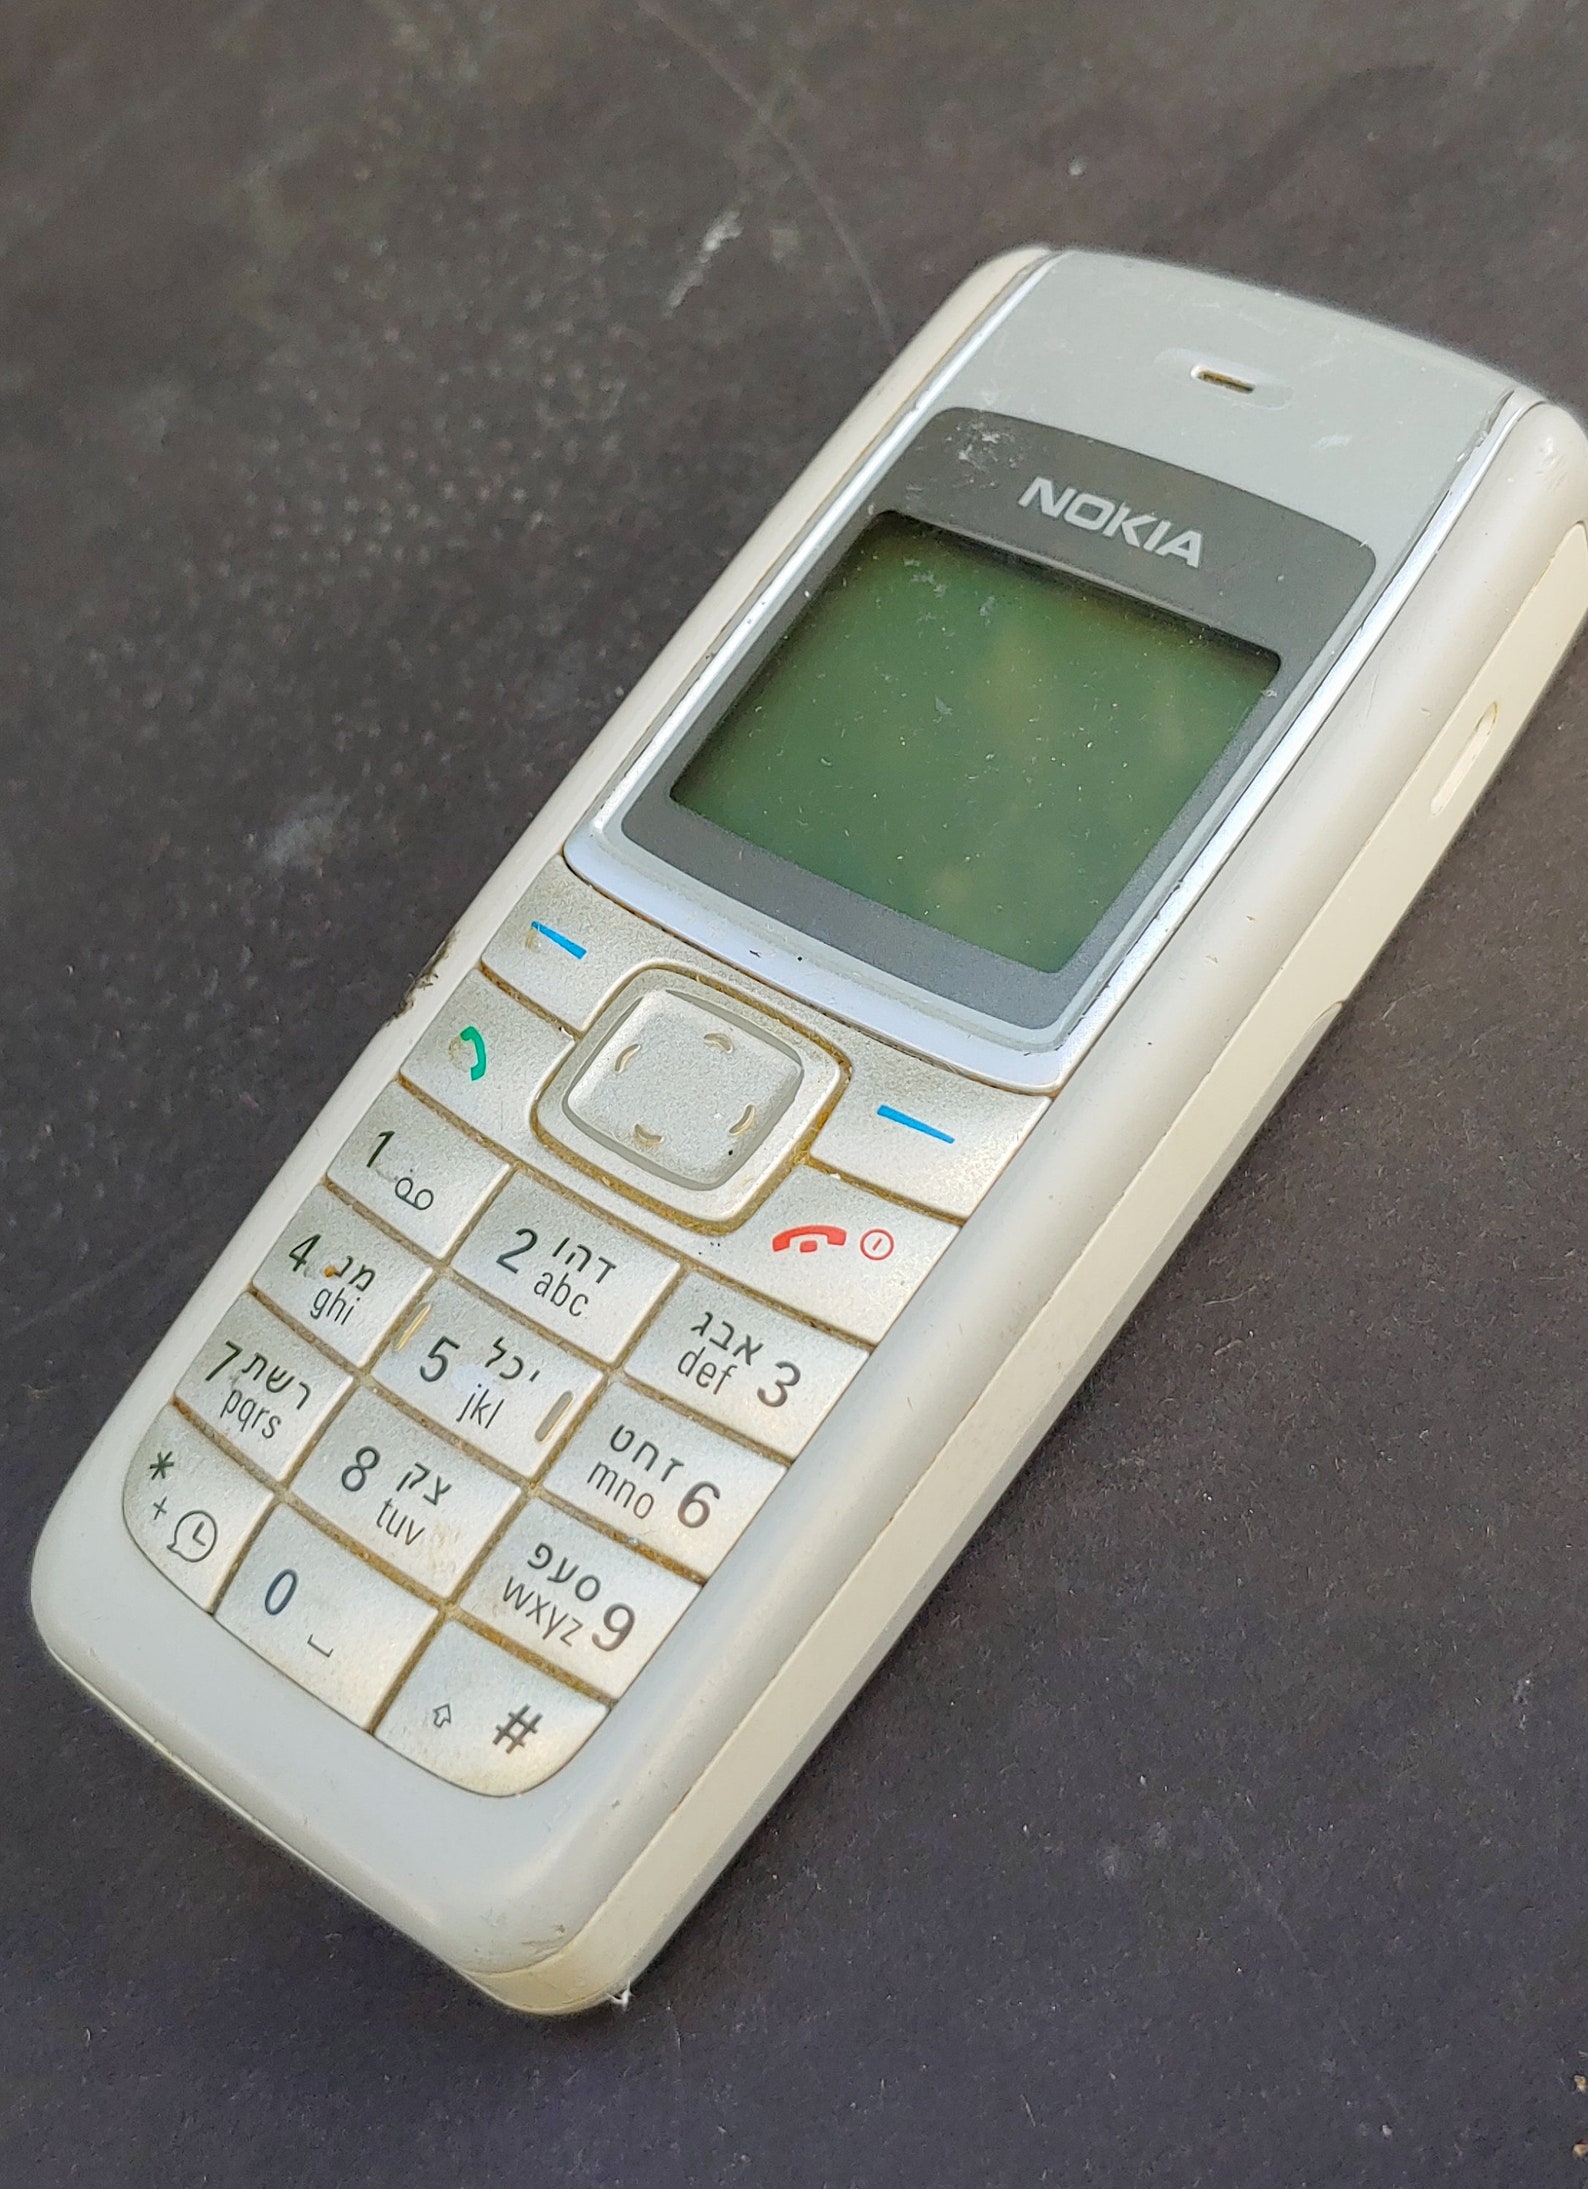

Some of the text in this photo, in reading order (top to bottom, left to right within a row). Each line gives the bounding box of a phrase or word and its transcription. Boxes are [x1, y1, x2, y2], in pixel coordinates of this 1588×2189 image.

[1018, 475, 1204, 568] NOKIA
[364, 1129, 396, 1169] 1
[287, 1233, 322, 1273] 4
[495, 1227, 538, 1274] 2
[551, 1236, 617, 1285] דהו
[310, 1287, 360, 1327] ghi
[533, 1271, 590, 1318] abc
[204, 1340, 242, 1383] 7
[418, 1336, 461, 1382] 5
[484, 1336, 541, 1383] יכל
[690, 1311, 764, 1366] אבג
[241, 1351, 311, 1410] רשת
[677, 1346, 738, 1396] def
[756, 1360, 801, 1408] 3
[220, 1386, 281, 1440] pqrs
[456, 1383, 505, 1430] jkl
[340, 1446, 381, 1492] 8
[610, 1423, 684, 1484] זחט
[396, 1462, 452, 1505] צק
[586, 1461, 655, 1520] mno
[677, 1480, 721, 1529] 6
[375, 1497, 426, 1547] tuv
[264, 1569, 299, 1616] 0
[526, 1542, 601, 1603] סעפ
[502, 1575, 584, 1648] wxyz
[592, 1602, 636, 1652] 9
[491, 1704, 543, 1754] #
